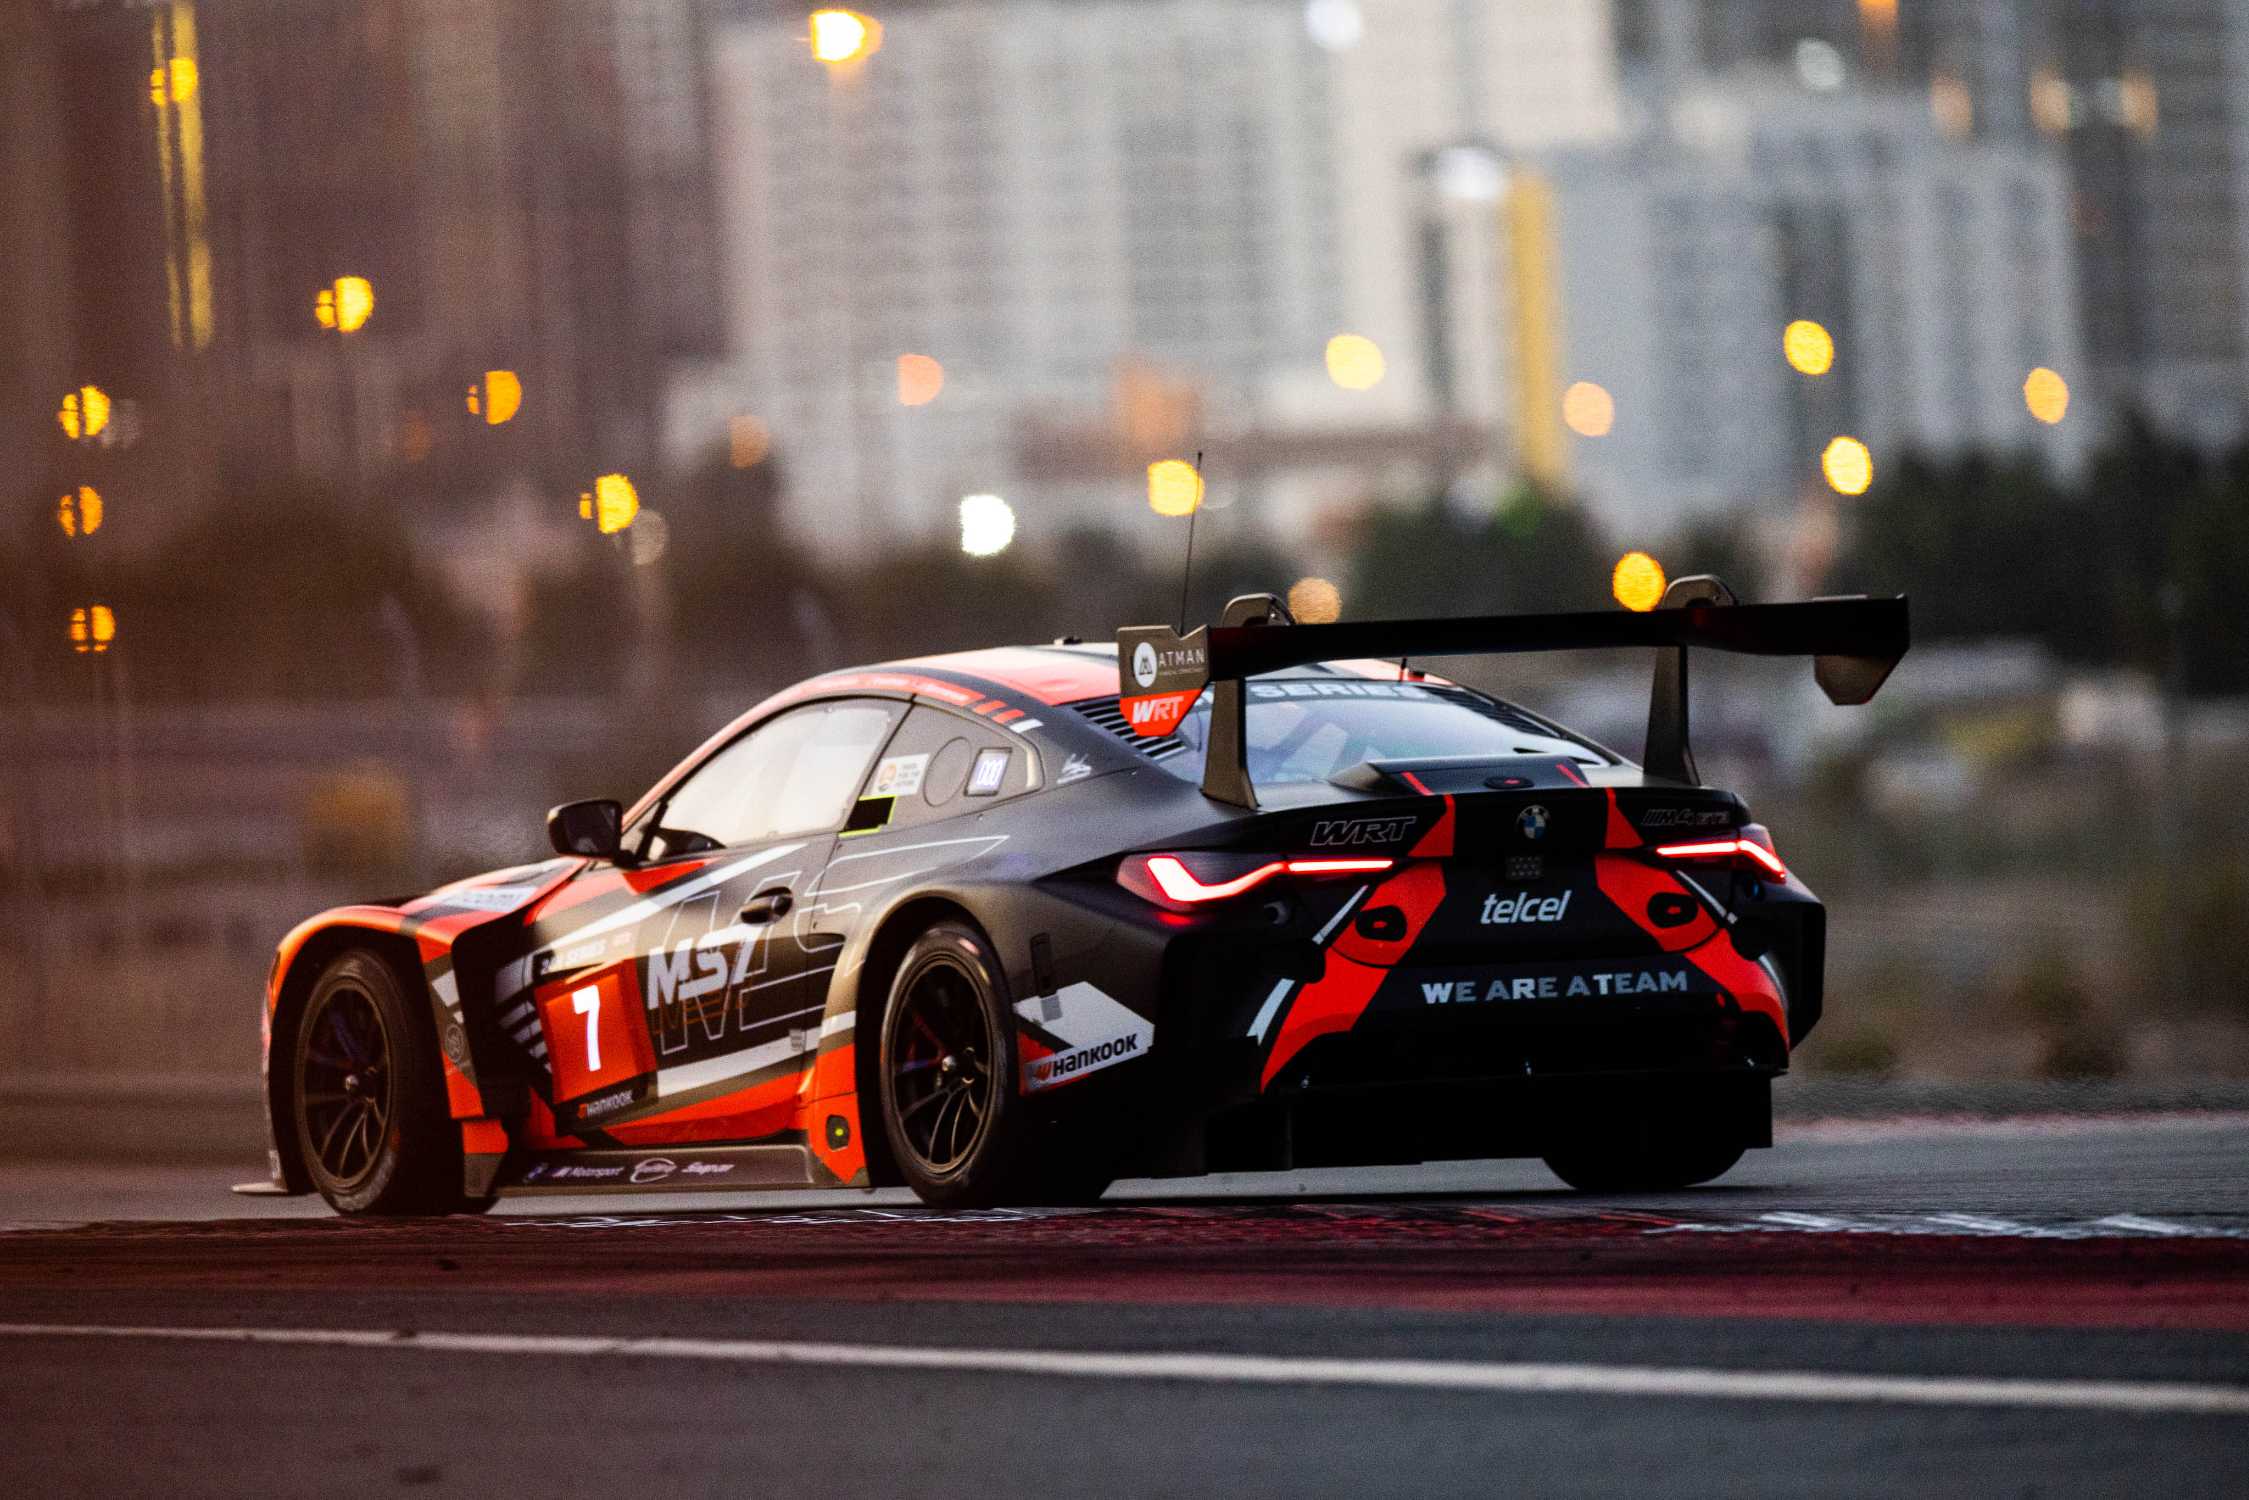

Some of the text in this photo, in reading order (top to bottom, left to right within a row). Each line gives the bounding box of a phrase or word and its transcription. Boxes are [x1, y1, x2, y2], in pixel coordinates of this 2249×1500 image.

[1158, 648, 1205, 668] ATMAN
[1253, 683, 1428, 699] SERIES
[1132, 696, 1184, 724] WRT
[1310, 816, 1417, 846] WRT
[1480, 890, 1572, 924] telcel
[1421, 981, 1477, 1005] WE
[1485, 976, 1559, 1001] ARE
[571, 984, 602, 1072] 7
